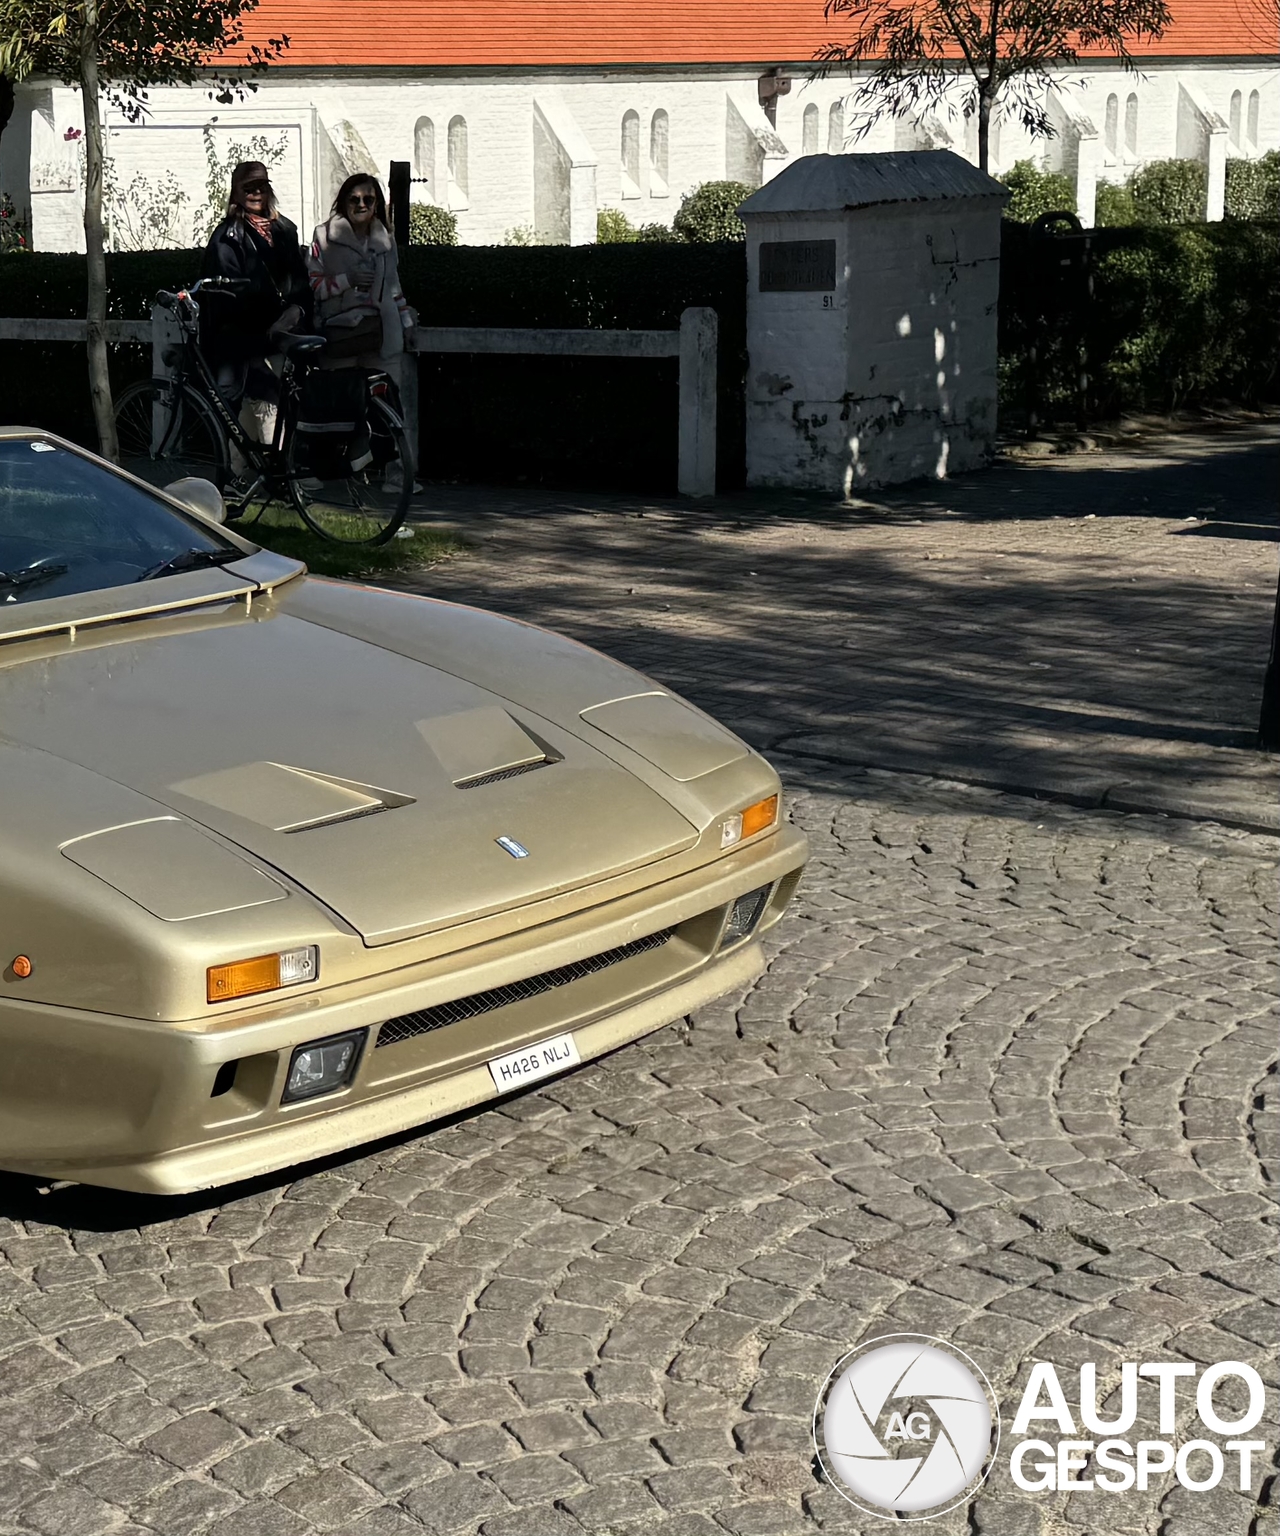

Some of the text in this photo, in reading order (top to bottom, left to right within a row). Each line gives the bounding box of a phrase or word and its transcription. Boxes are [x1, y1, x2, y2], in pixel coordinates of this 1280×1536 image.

[823, 295, 833, 307] 91
[209, 389, 244, 443] MERIDA
[500, 1042, 570, 1081] H426 NLJ
